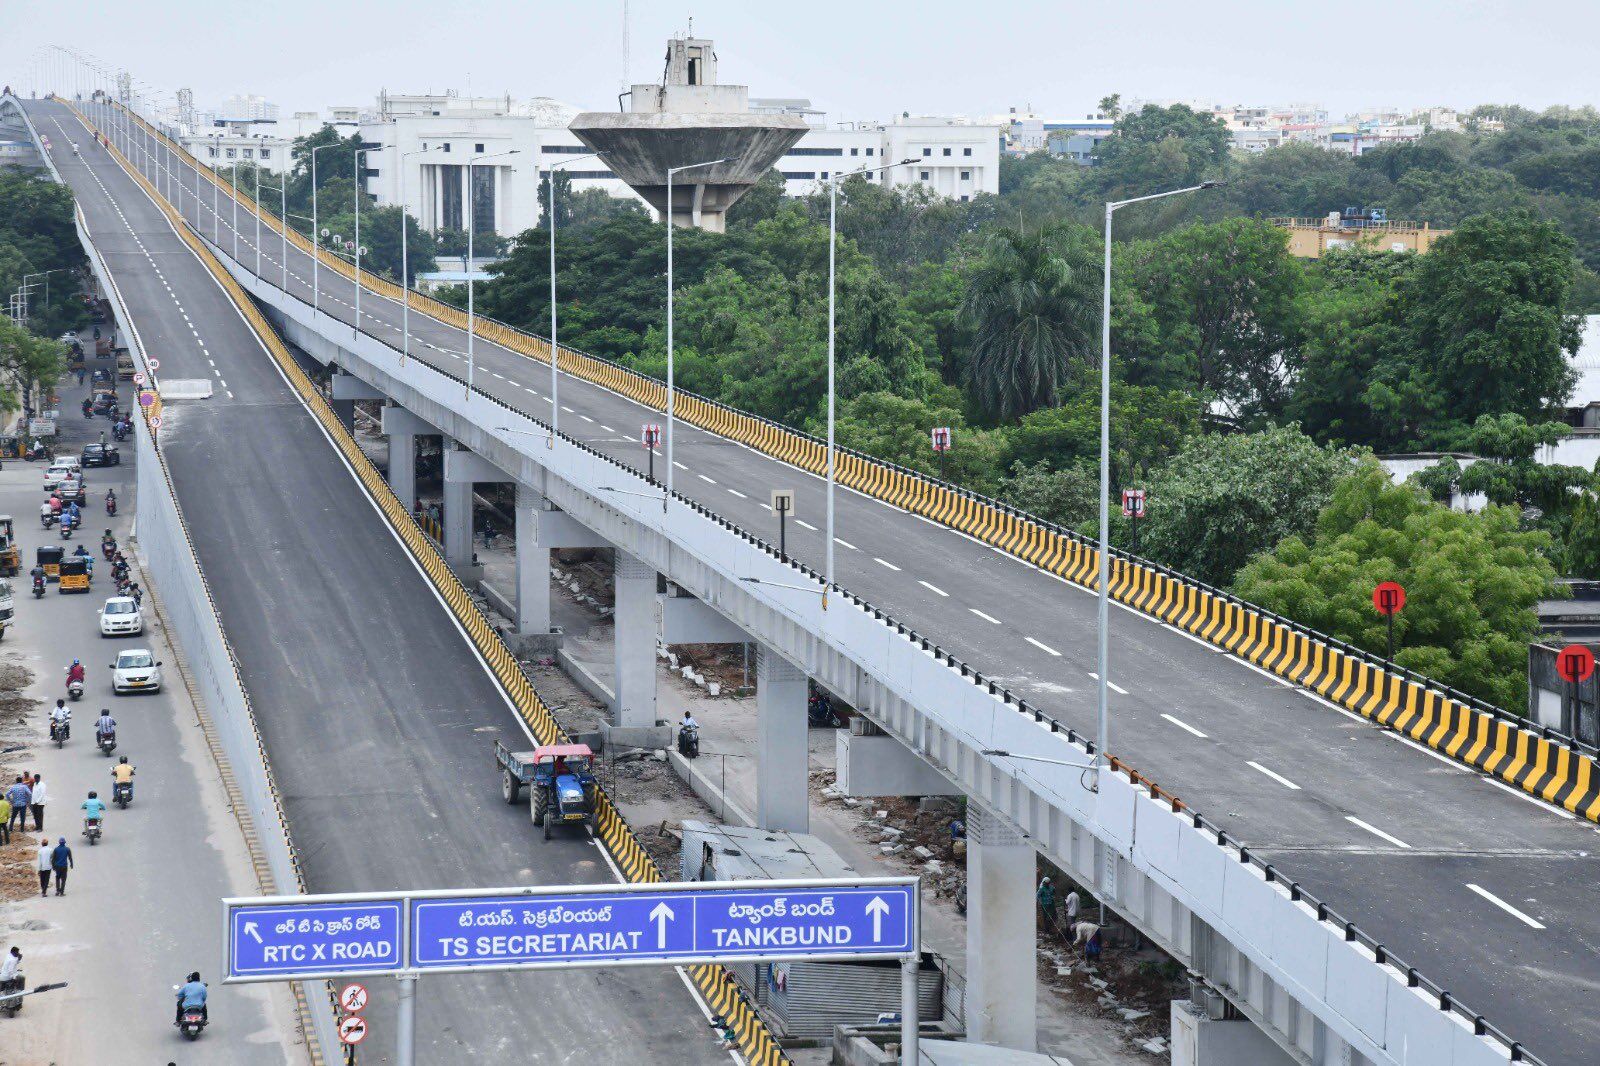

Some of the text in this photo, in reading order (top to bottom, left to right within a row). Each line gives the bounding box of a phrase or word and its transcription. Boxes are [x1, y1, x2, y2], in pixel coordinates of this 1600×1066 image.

[438, 931, 643, 957] TS SECRETARIAT
[711, 925, 852, 947] TANKBUND
[263, 940, 392, 963] RTC X ROAD
